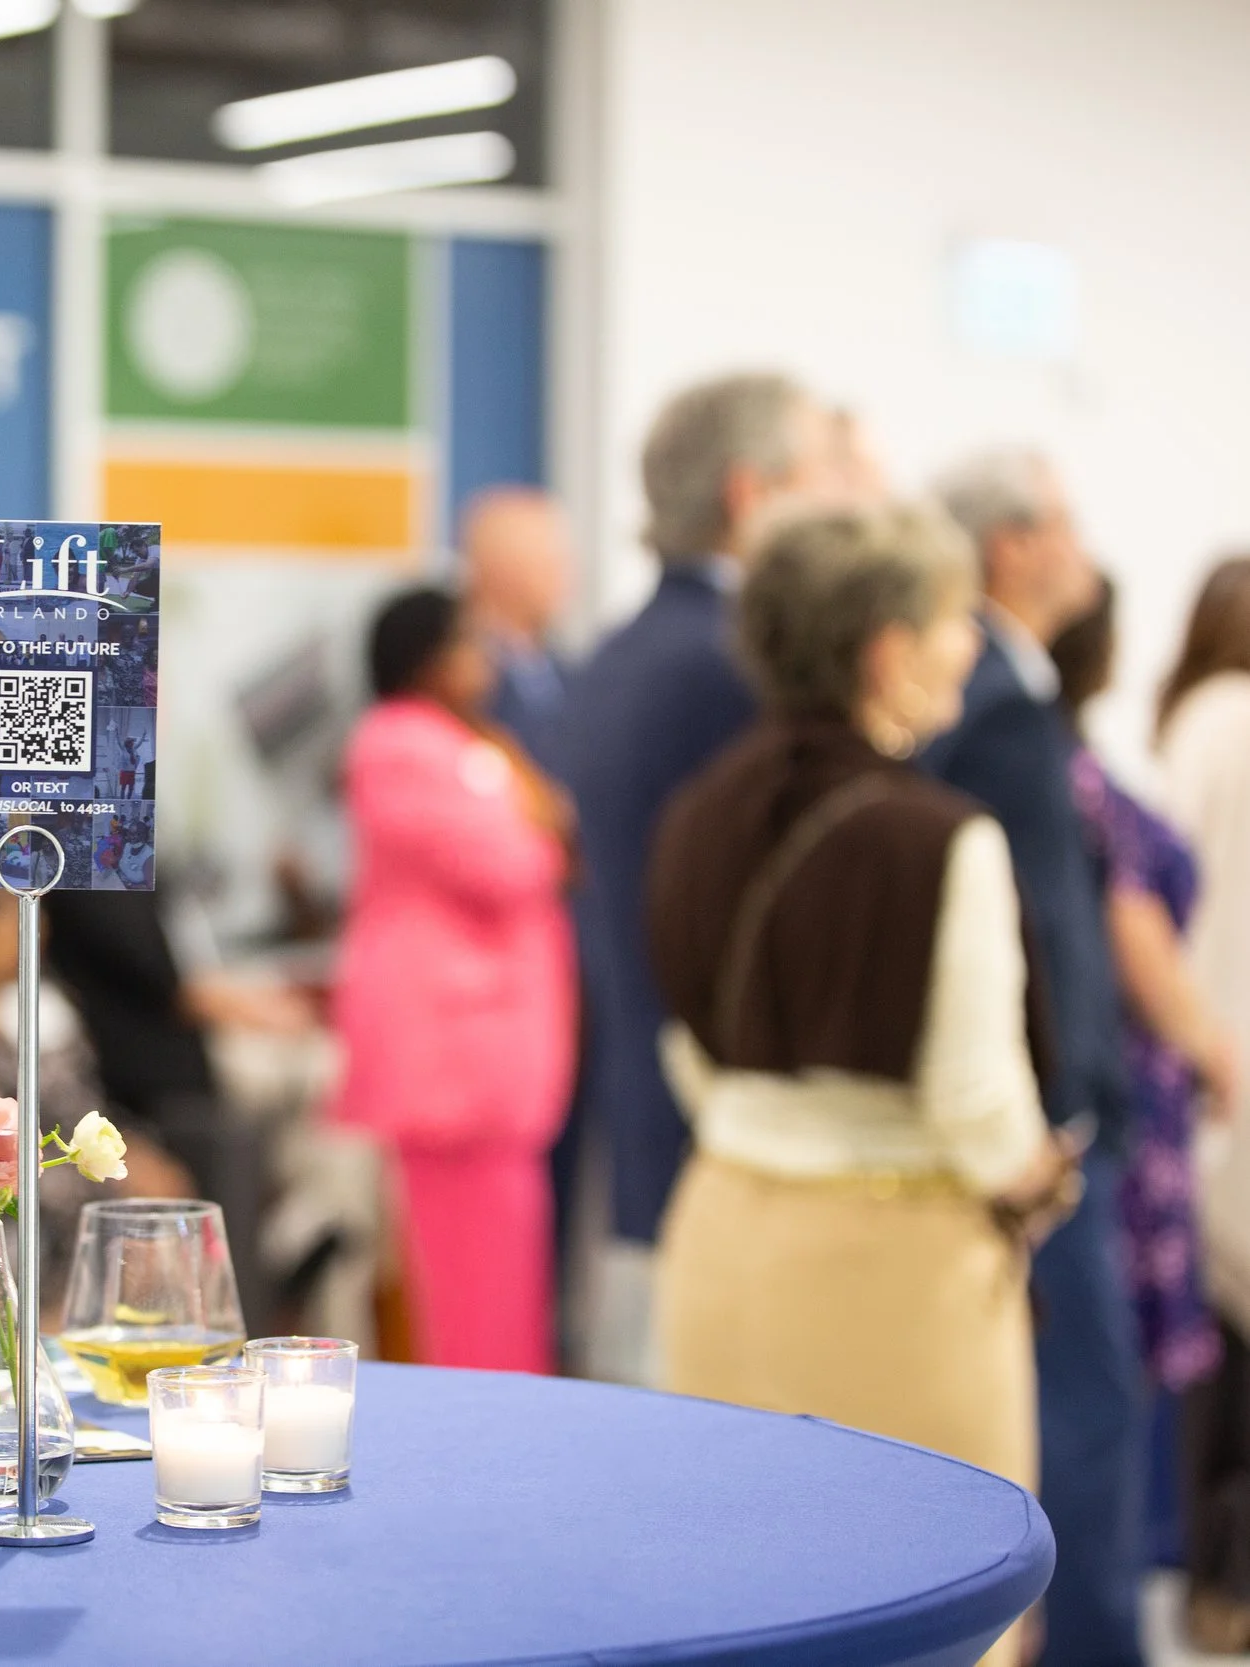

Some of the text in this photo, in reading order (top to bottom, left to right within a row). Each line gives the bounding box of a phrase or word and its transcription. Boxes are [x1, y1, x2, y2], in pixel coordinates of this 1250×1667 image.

[19, 641, 52, 654] THE
[55, 642, 121, 655] FUTURE
[11, 782, 69, 794] OR TEXT
[60, 802, 75, 813] to
[77, 803, 116, 815] 44321
